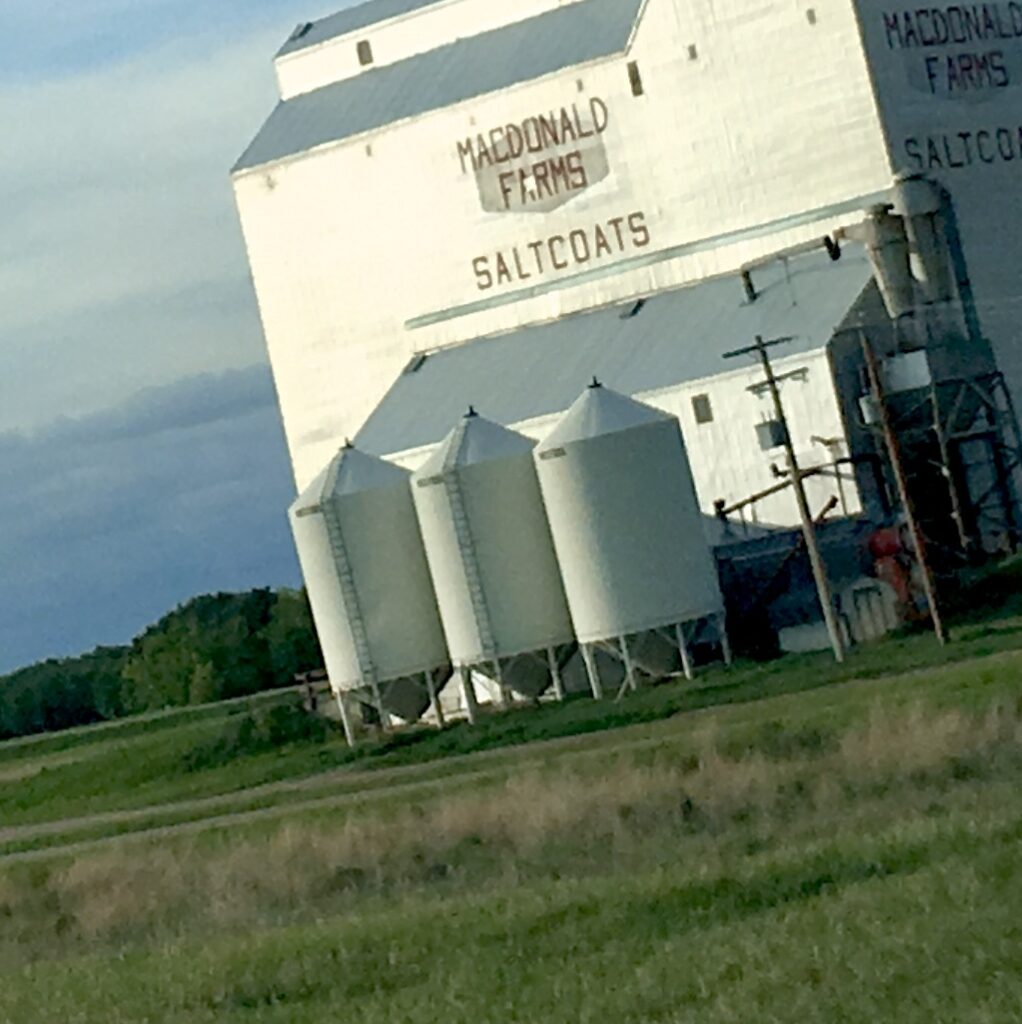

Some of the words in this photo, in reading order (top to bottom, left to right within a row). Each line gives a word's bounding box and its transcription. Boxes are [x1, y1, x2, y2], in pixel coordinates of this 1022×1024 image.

[925, 51, 1009, 94] FARMS
[456, 97, 608, 174] MACDONALD
[499, 150, 588, 209] FARMS
[472, 211, 651, 290] SALTCOATS
